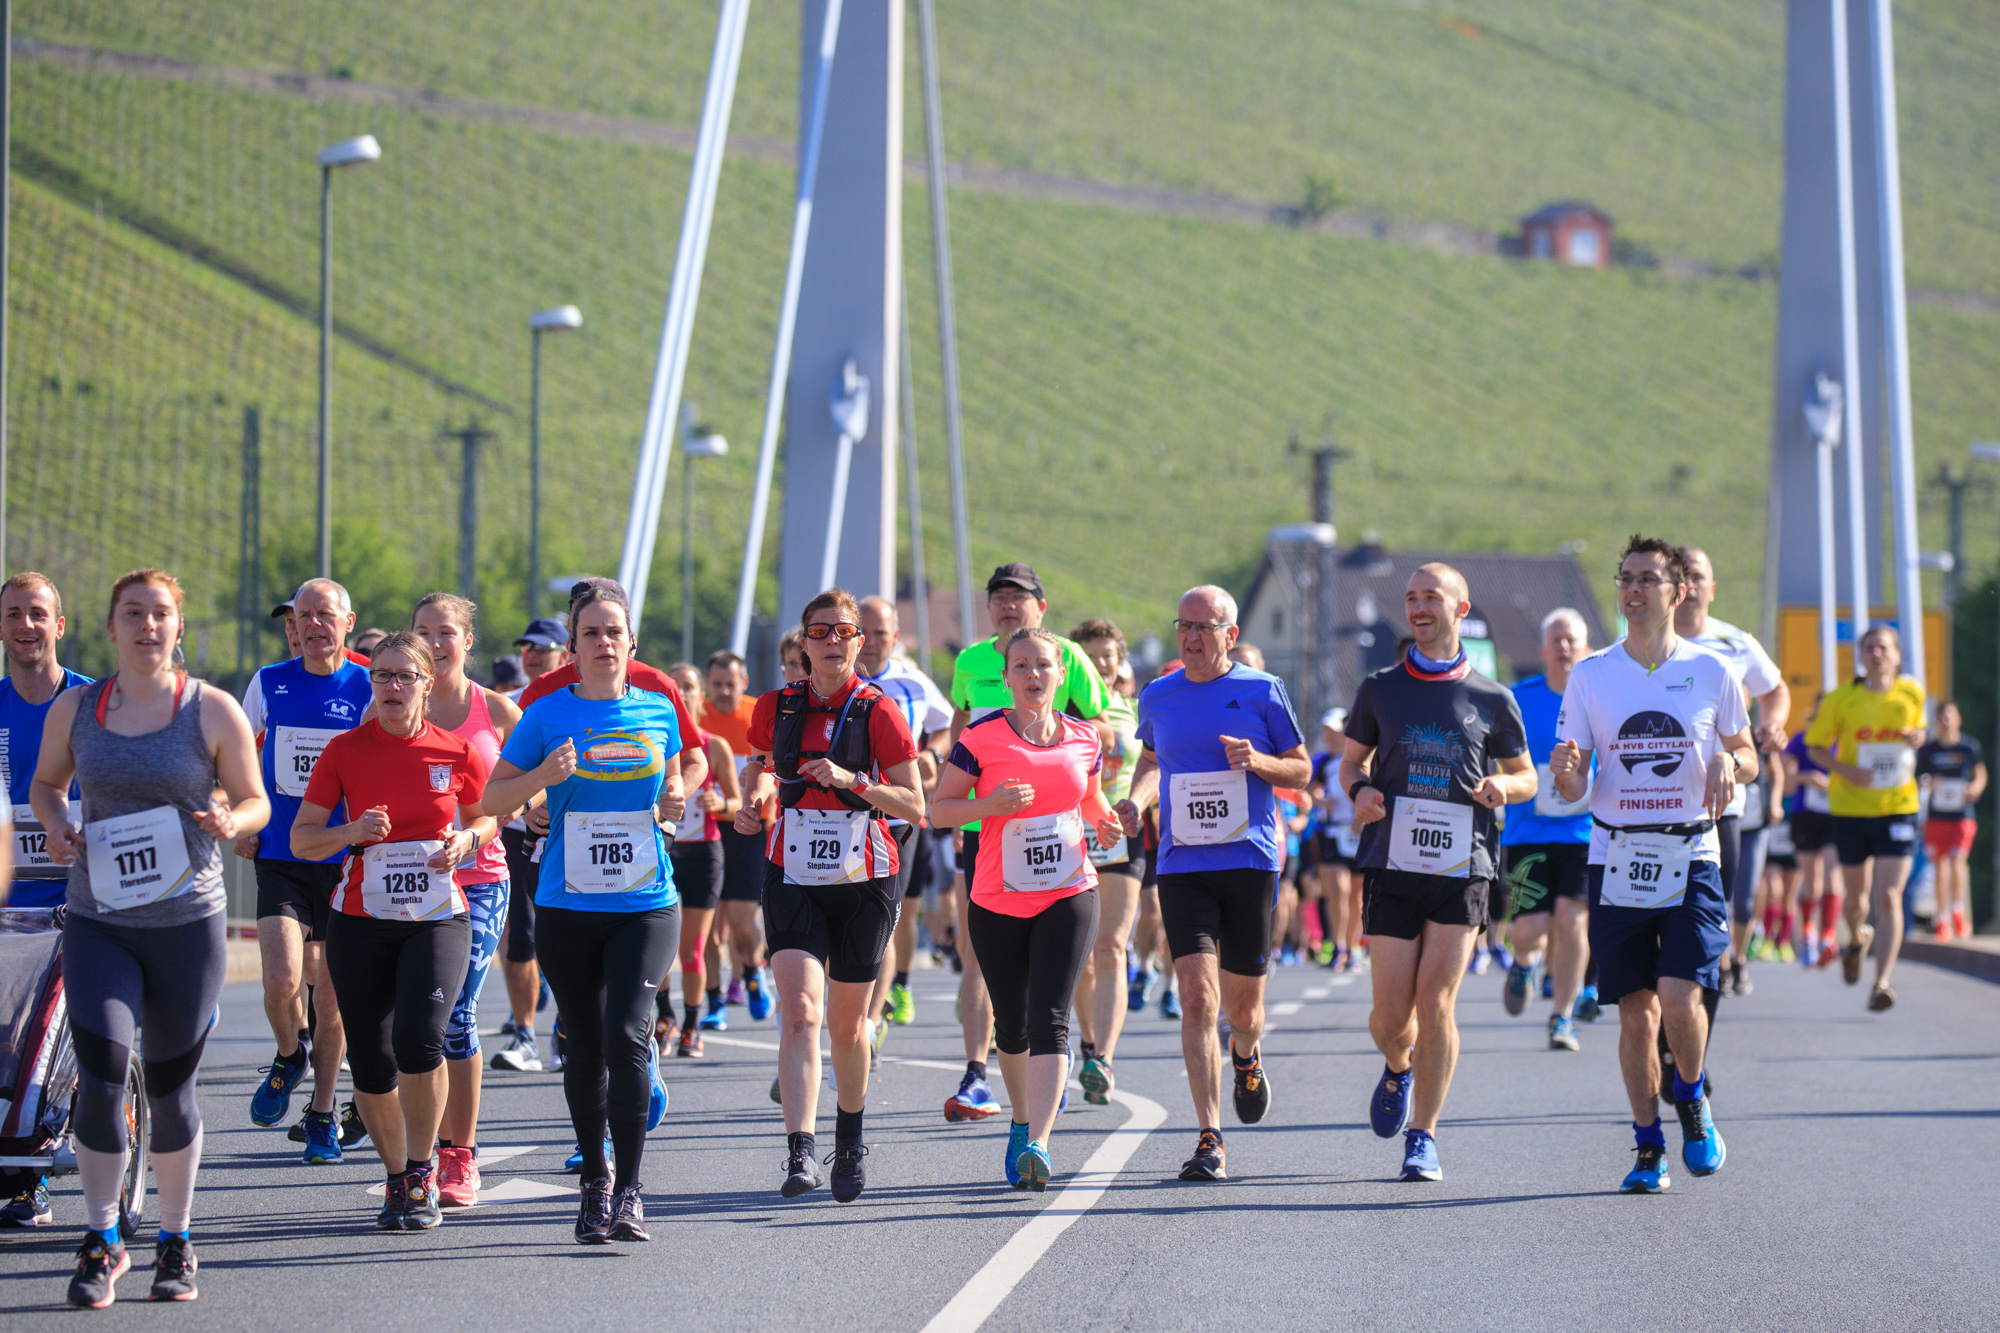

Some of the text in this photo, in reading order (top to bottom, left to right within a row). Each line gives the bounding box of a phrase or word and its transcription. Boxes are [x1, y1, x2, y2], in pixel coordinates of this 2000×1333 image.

[1623, 742, 1644, 750] HVB
[0, 728, 11, 792] ARBURG
[586, 748, 643, 760] BRUCHSAL
[292, 755, 320, 772] 132
[1408, 764, 1450, 777] MAINOVA
[1408, 775, 1450, 788] FRANKFURT
[1407, 785, 1449, 798] MARATHON
[1620, 786, 1684, 794] www.hvb-citylauf.de
[1186, 800, 1228, 820] 1353
[1620, 798, 1683, 810] FINISHER
[1416, 818, 1450, 827] Halbmarathon
[813, 828, 838, 836] Marathon
[1026, 834, 1058, 842] Halbmarathon
[1410, 827, 1452, 850] 1005
[19, 834, 47, 854] 112
[111, 835, 153, 848] Halbmarathon
[588, 842, 634, 864] 1783
[808, 840, 841, 860] 129
[1024, 843, 1062, 866] 1547
[1420, 850, 1440, 858] Daniel
[1635, 851, 1658, 859] Marathon
[30, 856, 54, 864] Tobias
[114, 846, 156, 876] 1717
[807, 862, 840, 870] Stephanie
[603, 868, 622, 876] Imke
[1034, 866, 1056, 876] Marina
[1628, 862, 1662, 882] 367
[120, 874, 162, 889] Florentine
[382, 872, 429, 894] 1283
[1630, 884, 1656, 892] Thomas
[391, 896, 422, 905] Angelika
